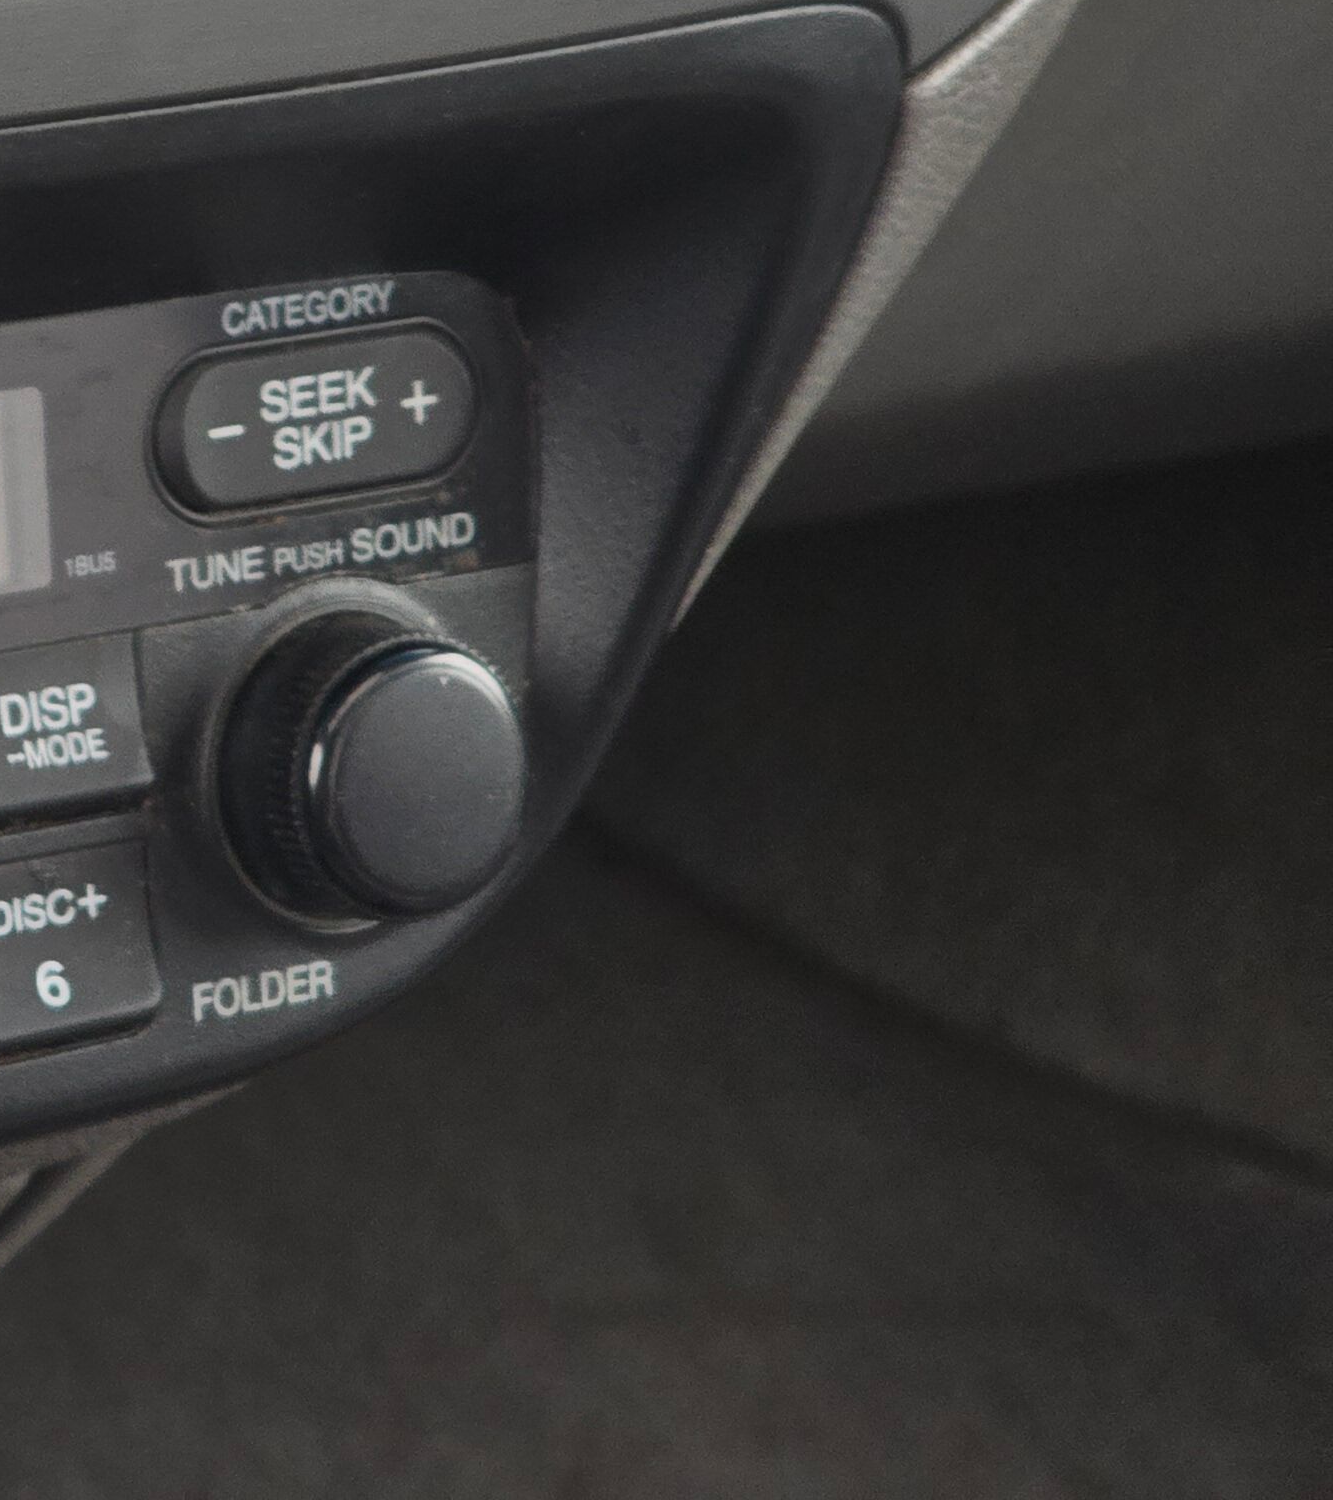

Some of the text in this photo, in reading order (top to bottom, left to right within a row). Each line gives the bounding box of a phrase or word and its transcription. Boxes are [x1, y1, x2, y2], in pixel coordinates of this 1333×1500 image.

[221, 280, 393, 337] CATEGORY
[259, 366, 376, 419] SEEK
[271, 418, 373, 471] SKIP
[165, 511, 475, 593] TUNE PUSH SOUND
[35, 959, 72, 1008] 6
[191, 959, 335, 1023] FOLDER
